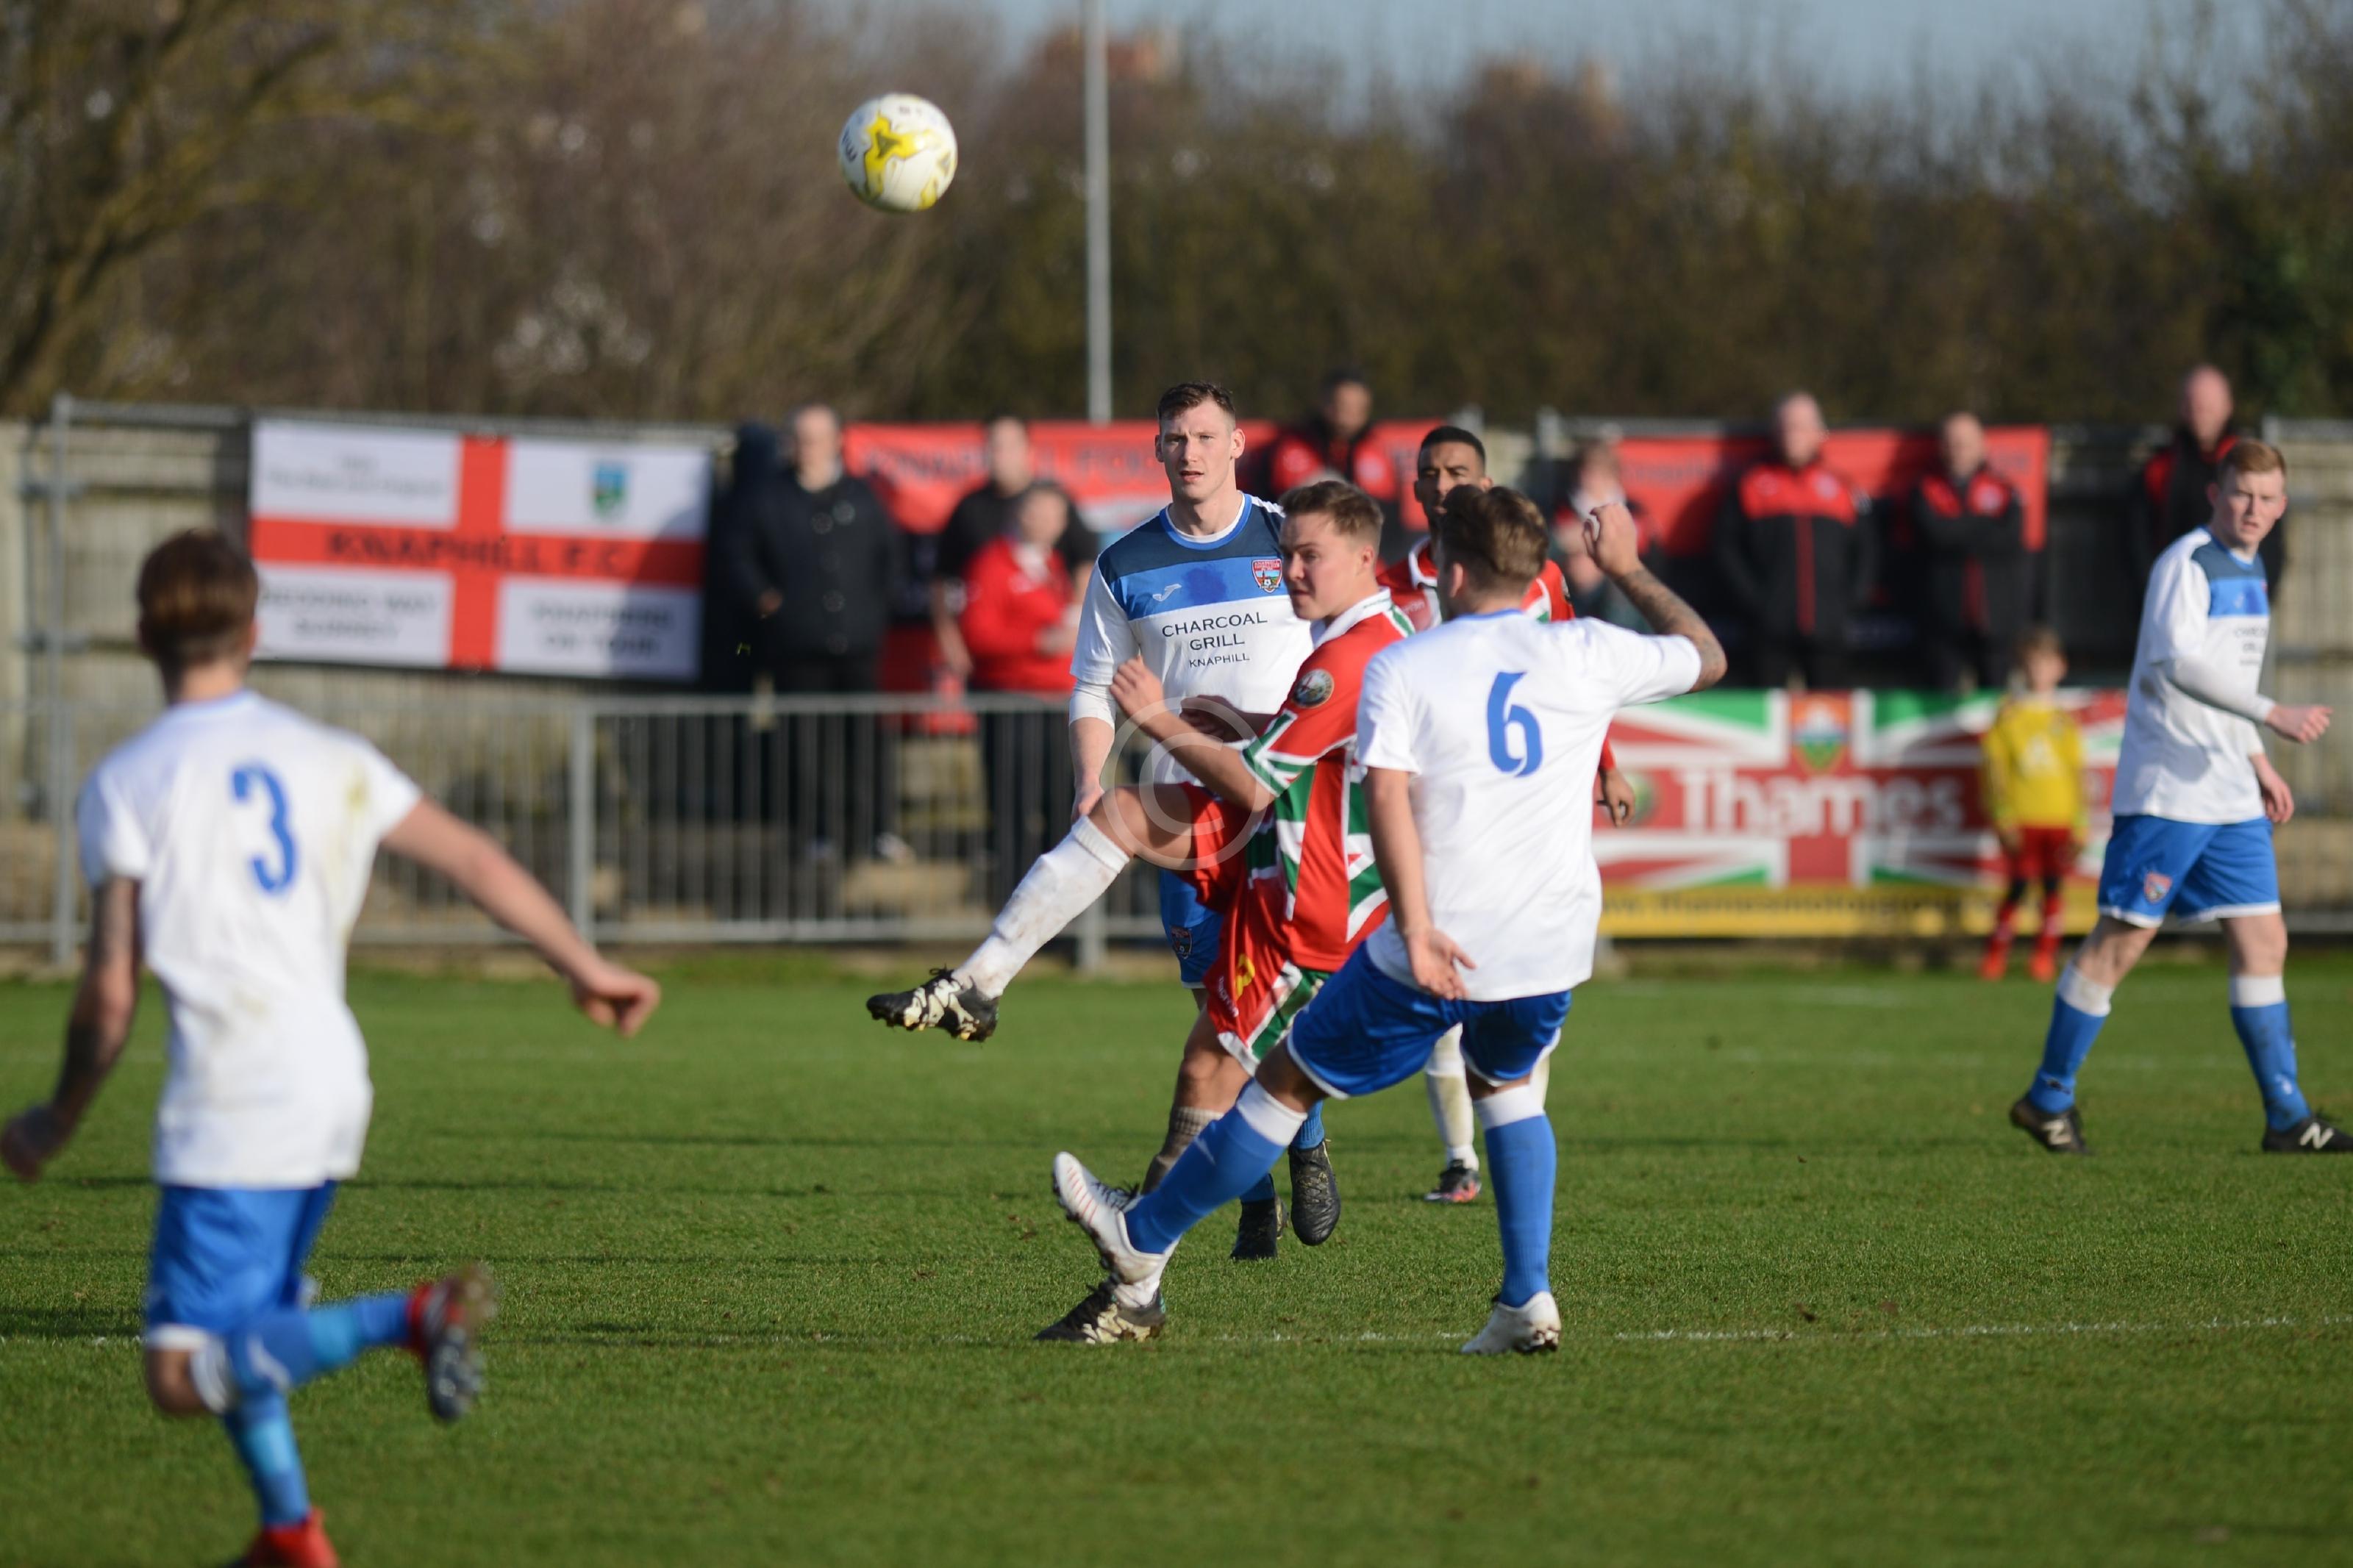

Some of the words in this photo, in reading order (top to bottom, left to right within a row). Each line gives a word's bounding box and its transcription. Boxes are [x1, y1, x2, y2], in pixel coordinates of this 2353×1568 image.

[1162, 612, 1268, 637] CHARCOAL
[1190, 634, 1245, 651] GRILL
[1189, 653, 1250, 668] KNAPHILL
[1488, 671, 1543, 778] 6
[1674, 767, 1965, 838] Thames
[229, 763, 297, 894] 3
